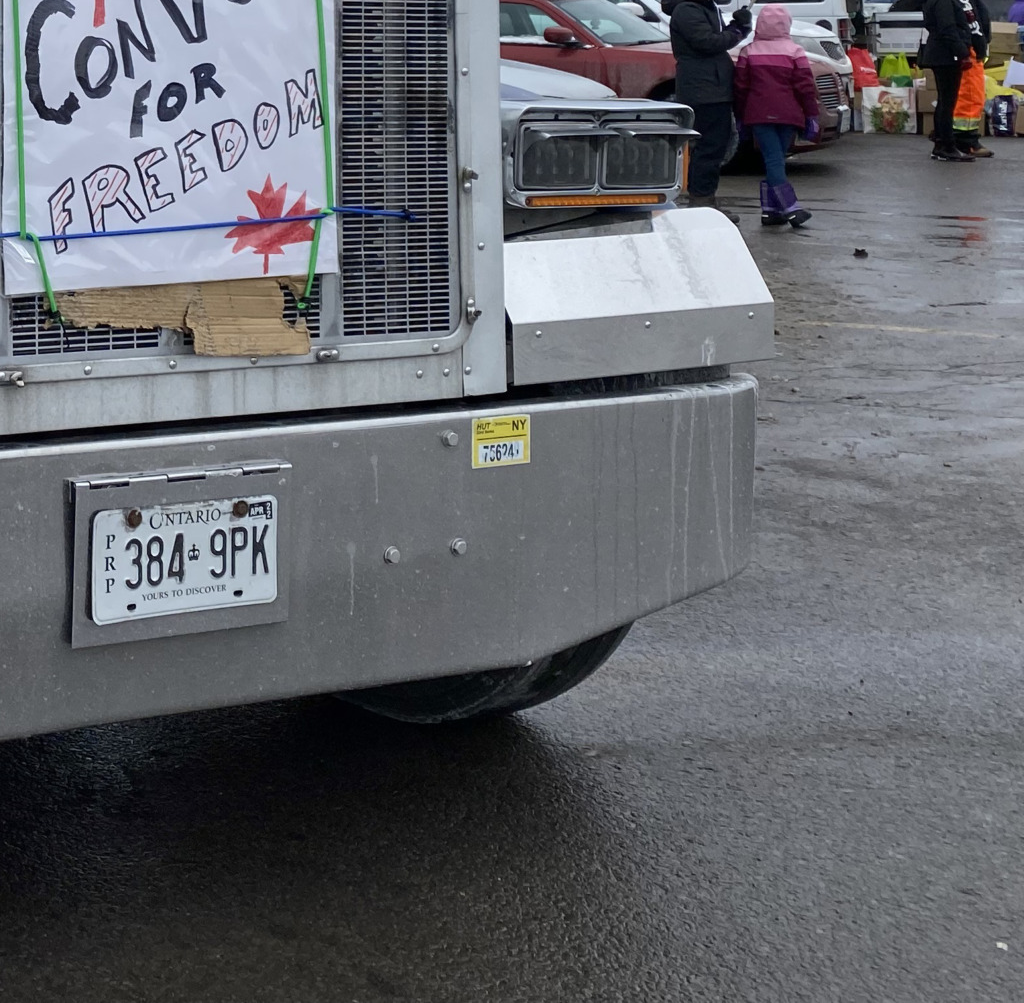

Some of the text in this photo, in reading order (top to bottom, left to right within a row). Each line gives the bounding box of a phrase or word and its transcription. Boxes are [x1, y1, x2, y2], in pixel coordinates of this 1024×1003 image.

[129, 63, 226, 139] FOR
[48, 69, 324, 254] FREEDOM
[476, 418, 527, 431] HUT NY
[149, 508, 222, 530] ONTARIO
[250, 506, 264, 516] APR
[125, 524, 269, 590] 384 9PK
[142, 584, 227, 602] YOURS TO DISCOVER
